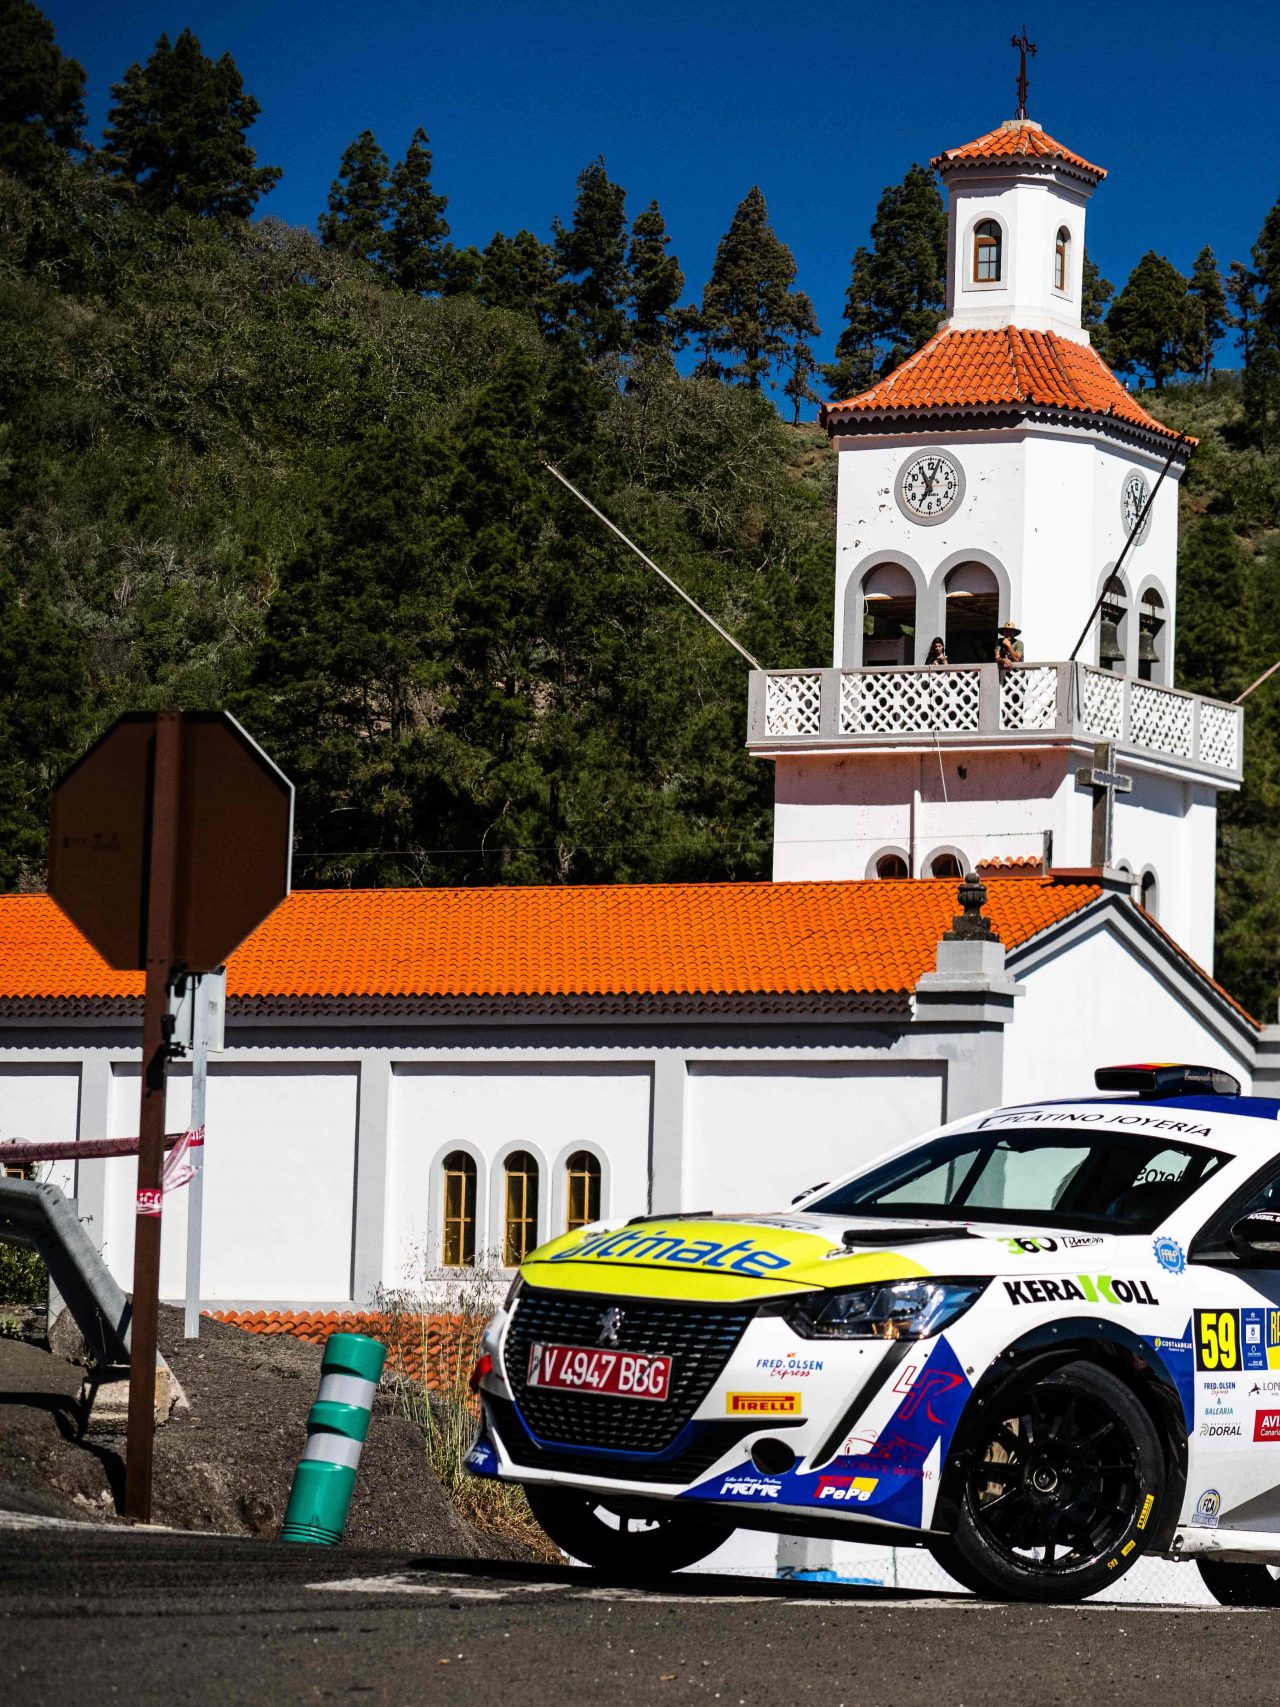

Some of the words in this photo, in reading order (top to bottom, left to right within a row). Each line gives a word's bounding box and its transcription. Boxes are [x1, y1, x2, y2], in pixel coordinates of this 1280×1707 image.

[944, 472, 949, 480] 2
[908, 483, 912, 491] 9
[948, 482, 952, 490] 3
[912, 492, 916, 500] 8
[943, 490, 948, 498] 4
[928, 502, 932, 510] 6
[937, 498, 942, 506] 5
[1001, 1113, 1104, 1124] PLATINO
[551, 1230, 791, 1278] ultimate
[1002, 1275, 1160, 1306] KERAKOLL
[1201, 1312, 1236, 1369] 59
[544, 1350, 558, 1382] V
[559, 1351, 617, 1388] 4947
[618, 1357, 665, 1394] BBG
[770, 1367, 811, 1380] Express
[732, 1395, 795, 1411] PIRELLI
[1208, 1426, 1242, 1436] DORAL
[720, 1483, 782, 1497] MEME
